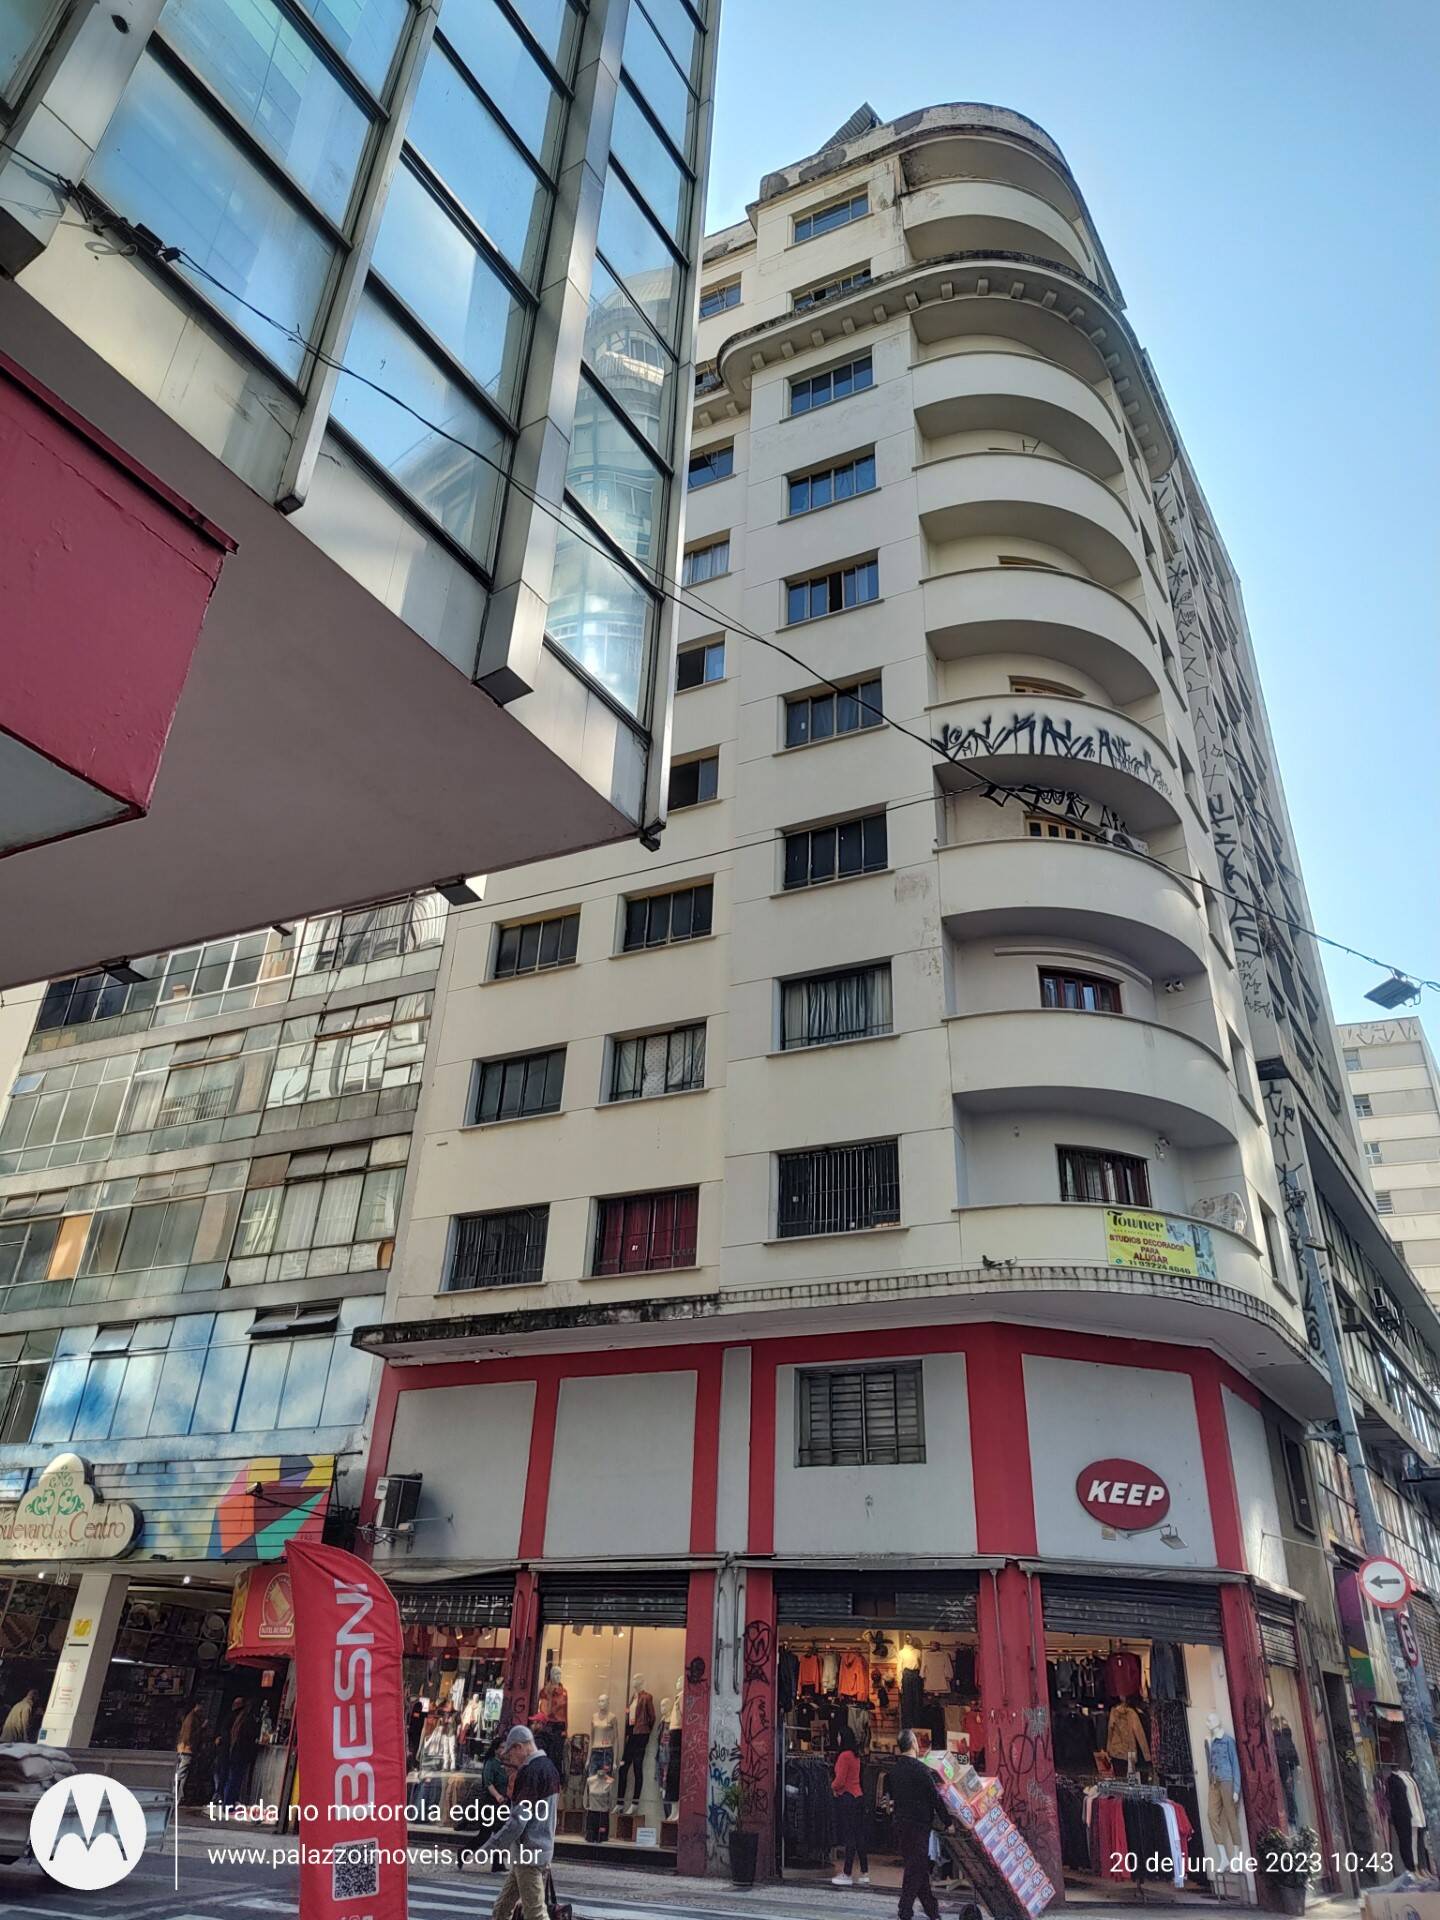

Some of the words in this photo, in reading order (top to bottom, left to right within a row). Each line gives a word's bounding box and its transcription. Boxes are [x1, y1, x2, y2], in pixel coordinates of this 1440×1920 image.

[1107, 1210, 1163, 1232] Towner
[1109, 1233, 1142, 1245] STUDIOS
[1143, 1237, 1185, 1252] DECORADOS
[1141, 1246, 1160, 1254] PARA
[1133, 1251, 1169, 1264] ALUGAR
[1087, 1480, 1166, 1507] KEEP
[0, 1515, 55, 1540] oulevard
[69, 1511, 126, 1543] Centro
[333, 1578, 374, 1820] BESNI
